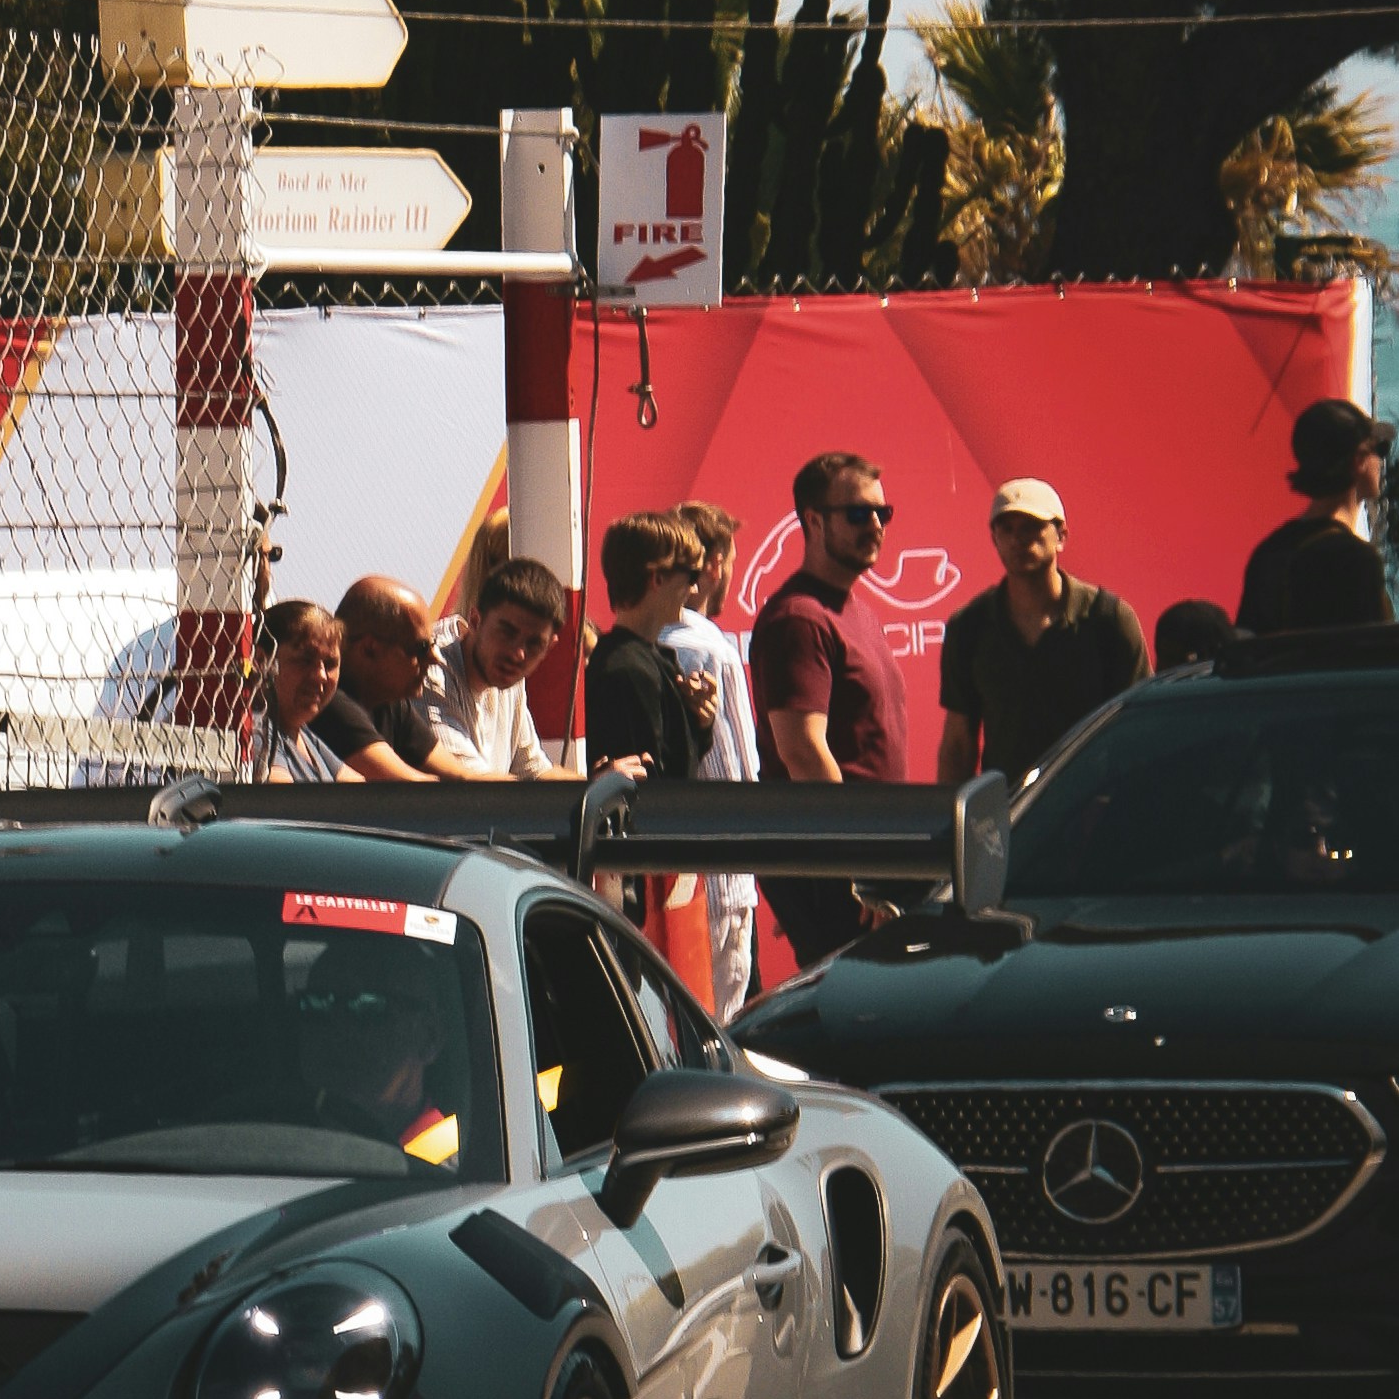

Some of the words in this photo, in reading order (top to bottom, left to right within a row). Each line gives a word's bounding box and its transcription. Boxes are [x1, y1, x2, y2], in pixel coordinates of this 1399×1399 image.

[278, 171, 310, 192] Bord
[317, 172, 332, 192] de
[340, 171, 368, 192] Mer
[328, 204, 396, 233] Rainier
[614, 223, 704, 244] FIRE
[994, 1271, 1201, 1317] W-816-CF
